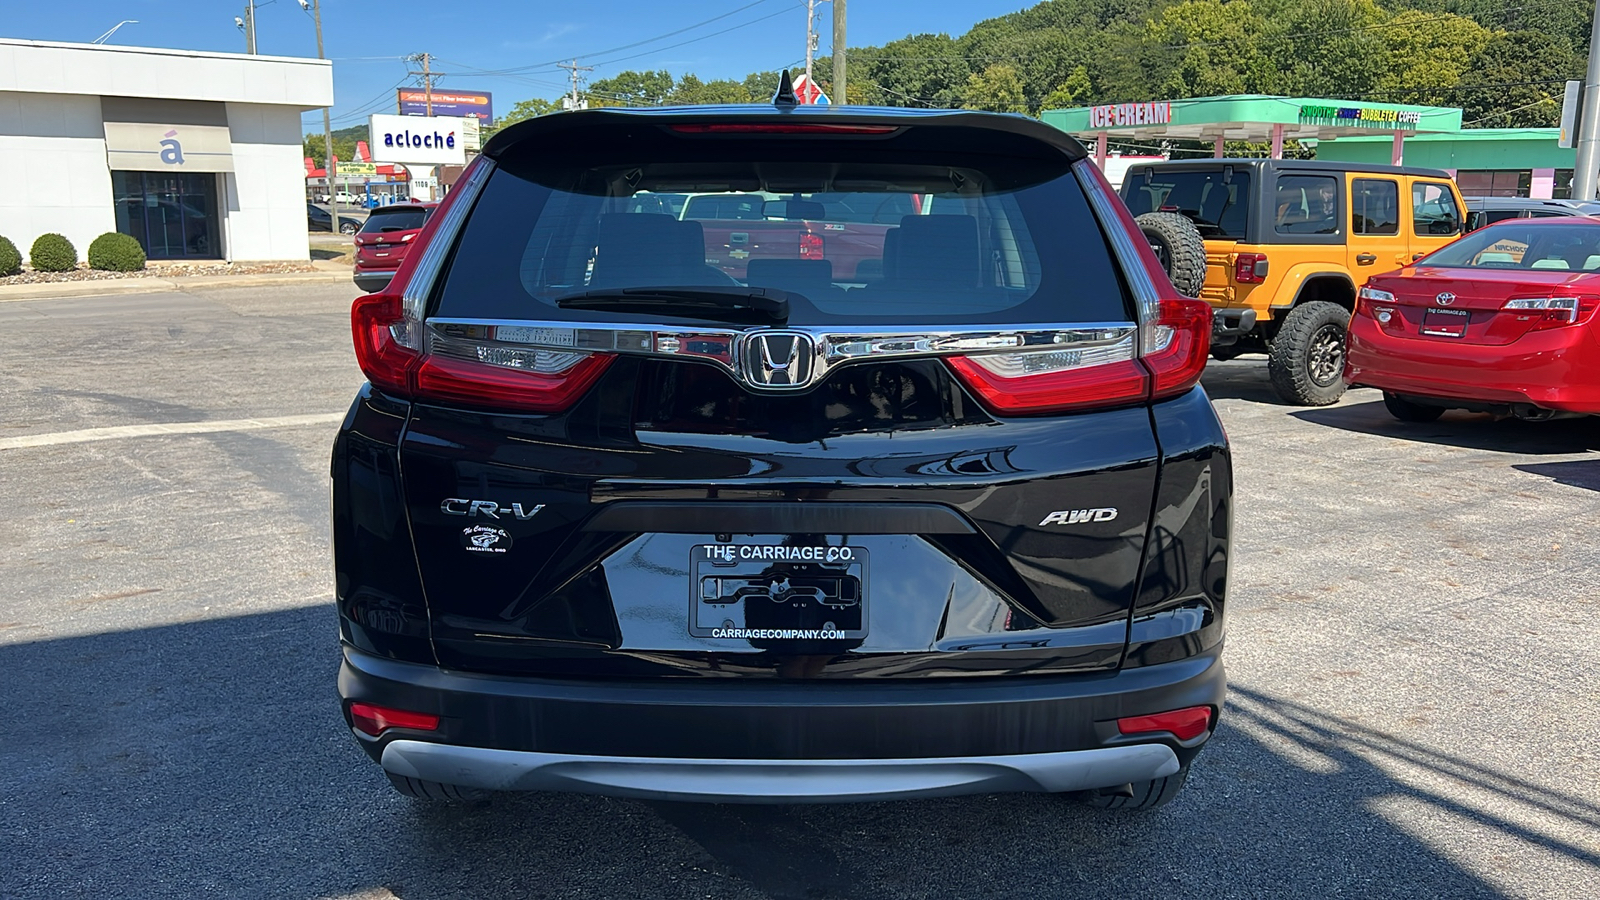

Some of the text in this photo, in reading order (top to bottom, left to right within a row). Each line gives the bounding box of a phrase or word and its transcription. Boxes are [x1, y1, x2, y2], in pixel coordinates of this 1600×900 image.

[1089, 102, 1170, 128] ICE CREAM
[1398, 111, 1421, 123] COFFEE
[384, 130, 455, 149] acloché
[441, 498, 546, 520] CR-V
[1039, 507, 1118, 526] AWD
[704, 545, 855, 561] THE CARRIAGE CO.
[712, 628, 845, 640] CARRIAGECOMPANY.COM
